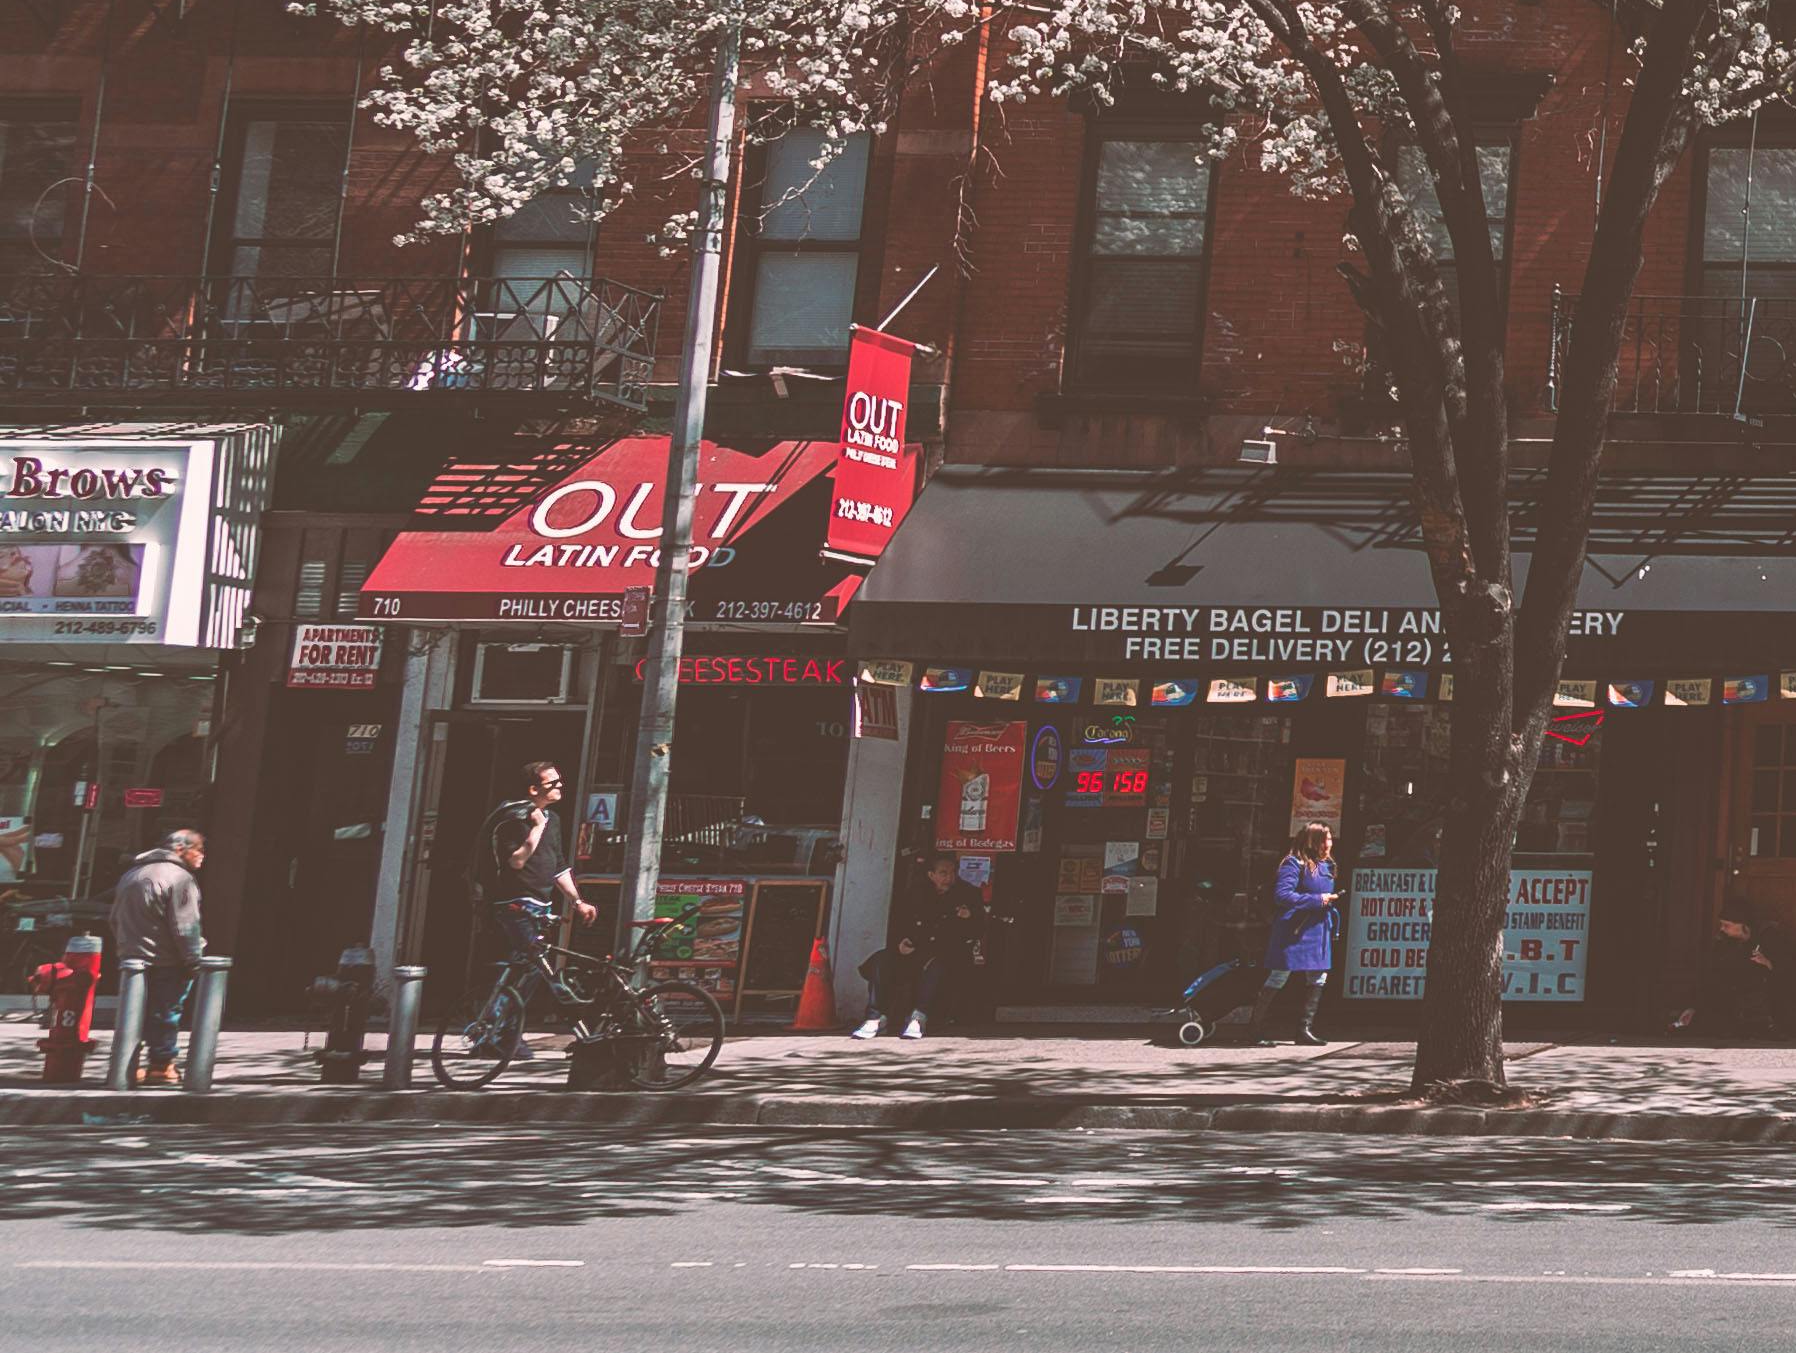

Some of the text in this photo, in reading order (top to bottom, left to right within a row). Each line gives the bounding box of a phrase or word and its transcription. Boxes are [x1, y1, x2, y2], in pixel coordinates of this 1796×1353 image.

[850, 391, 903, 438] OUT
[873, 433, 899, 454] FOOD
[0, 509, 68, 534] ALON
[502, 545, 613, 568] LATIN
[374, 598, 401, 616] 710
[500, 599, 558, 617] PHILLY
[716, 601, 822, 621] 212-397-4612
[1072, 608, 1199, 632] LIBERTY
[1209, 608, 1311, 633] BAGEL
[1321, 610, 1388, 633] DELI
[1398, 611, 1447, 634] AN
[303, 628, 379, 644] APARTMENTS
[299, 644, 377, 666] FOR RENT
[1125, 638, 1200, 660] FREE
[1210, 639, 1353, 662] DELIVERY
[1363, 640, 1431, 665] (212)
[987, 675, 1012, 685] PLAY
[1103, 681, 1129, 691] PLAY
[1560, 683, 1584, 693] PLAY
[1674, 682, 1701, 692] PLAY
[349, 724, 380, 738] 710
[1085, 725, 1129, 740] Corona
[944, 744, 1016, 754] King of Beers
[1077, 771, 1149, 793] 96 158
[590, 798, 610, 822] A
[935, 839, 954, 850] ing
[956, 838, 967, 848] of
[1354, 872, 1426, 893] BREAKFAST &
[1516, 878, 1589, 905] ACCEPT
[1360, 898, 1385, 917] HOT
[1387, 898, 1416, 917] COFF
[1511, 912, 1586, 931] STAMP BENEFIT
[1367, 922, 1431, 942] GROCER
[1360, 948, 1400, 968] COLD
[1507, 939, 1580, 961] .B.T
[1349, 975, 1427, 996] CIGARET
